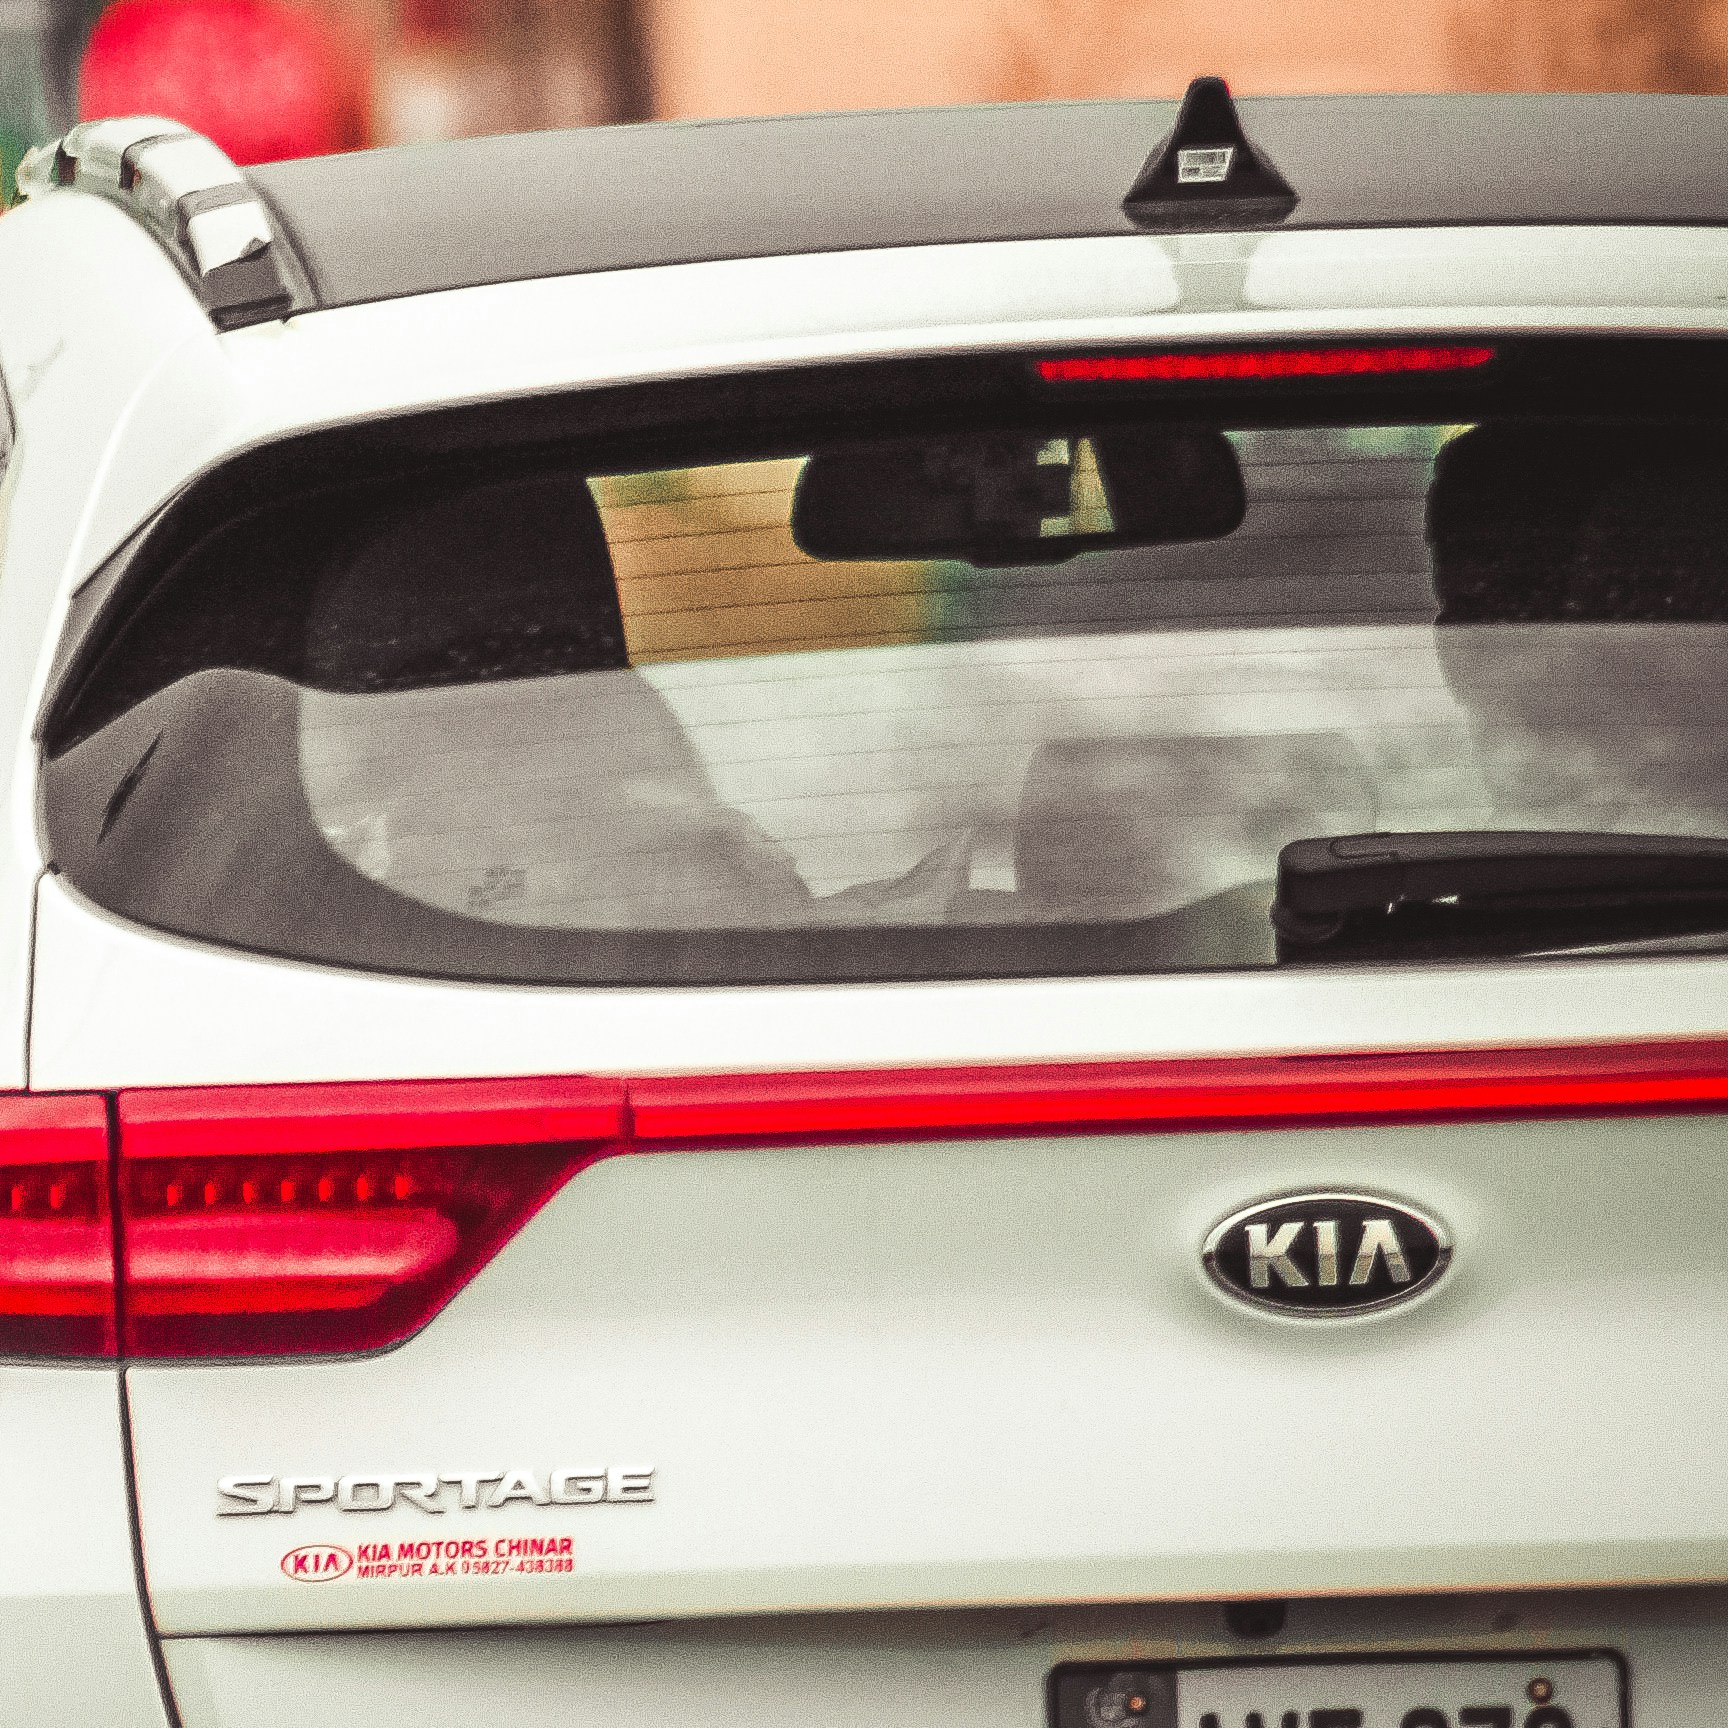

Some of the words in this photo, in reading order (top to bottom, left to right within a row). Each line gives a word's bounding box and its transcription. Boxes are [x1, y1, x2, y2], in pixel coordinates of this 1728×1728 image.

[1244, 1219, 1411, 1288] KIA
[216, 1465, 656, 1518] SPORTAGE
[357, 1543, 392, 1562] KIA
[397, 1539, 488, 1561] MOTORS
[494, 1536, 574, 1558] CHINAR
[292, 1552, 340, 1575] KIA
[357, 1562, 423, 1578] MIRPUR
